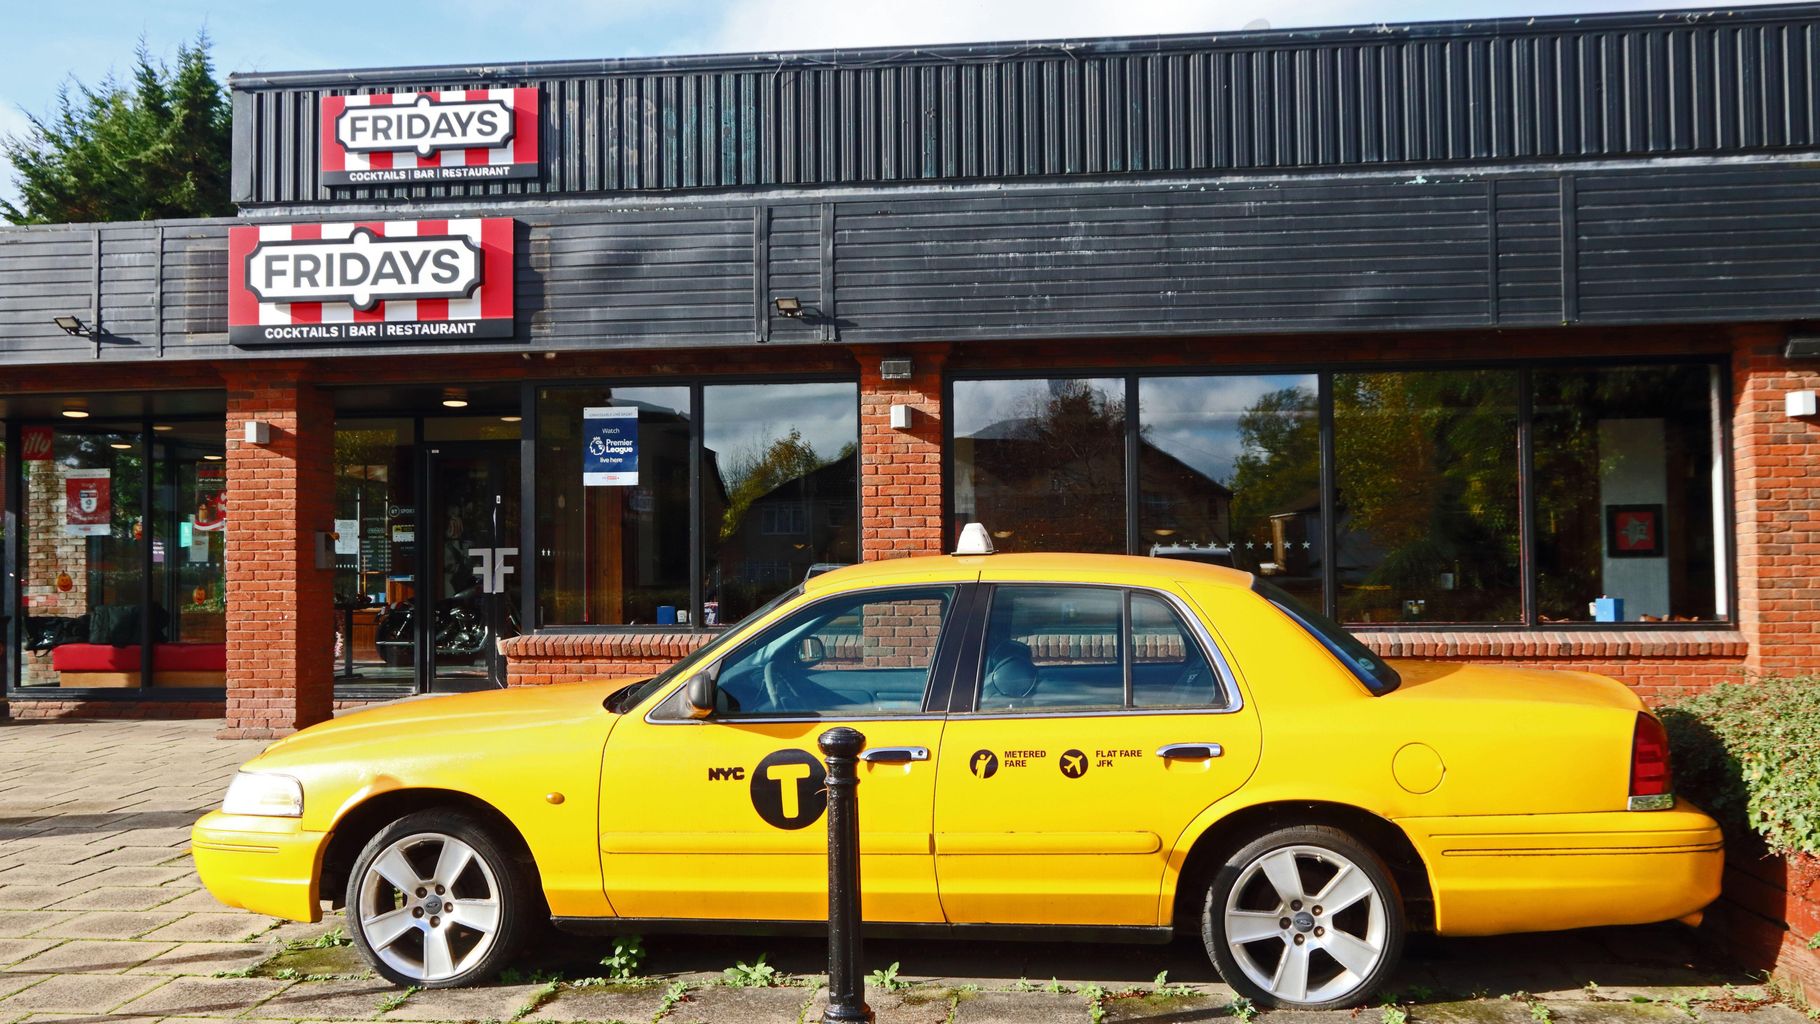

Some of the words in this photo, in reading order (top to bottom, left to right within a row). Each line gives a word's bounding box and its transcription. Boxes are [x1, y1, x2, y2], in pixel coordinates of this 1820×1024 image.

[349, 110, 498, 142] FRIDAYS
[349, 170, 406, 181] COCKTAILS
[413, 169, 434, 179] BAR
[442, 166, 510, 178] RESTAURANT
[264, 249, 460, 288] FRIDAYS
[265, 326, 339, 339] COCKTAILS
[349, 325, 376, 336] BAR
[387, 322, 476, 335] RESTAURANT
[606, 446, 633, 454] League
[1004, 750, 1047, 758] METERED
[1096, 750, 1117, 758] FLAT
[1004, 760, 1027, 768] FARE
[1096, 760, 1113, 768] JFK
[708, 767, 745, 781] NYC
[766, 763, 811, 819] T
